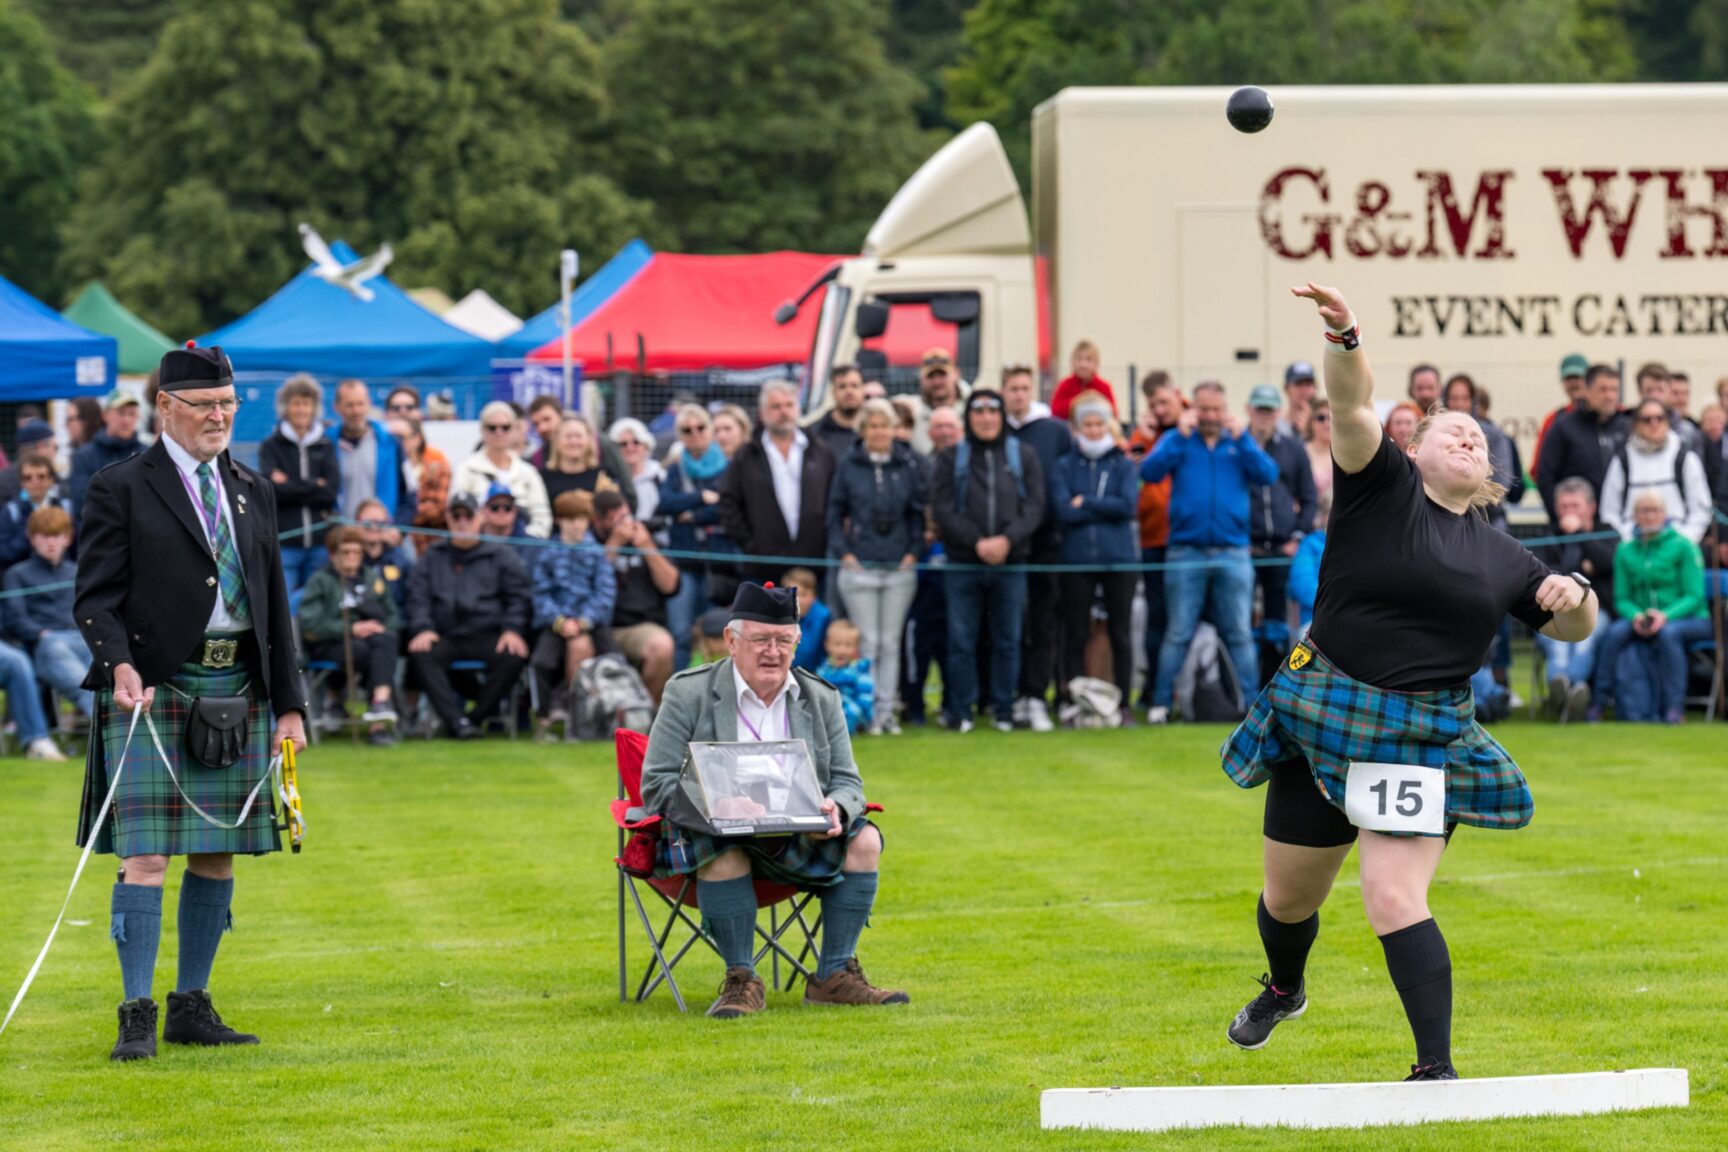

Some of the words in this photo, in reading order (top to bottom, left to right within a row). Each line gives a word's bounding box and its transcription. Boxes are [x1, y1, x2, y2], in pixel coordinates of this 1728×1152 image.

[1258, 166, 1516, 262] G&M
[1540, 166, 1728, 262] WH
[1391, 295, 1560, 338] EVENT
[1369, 779, 1423, 816] 15
